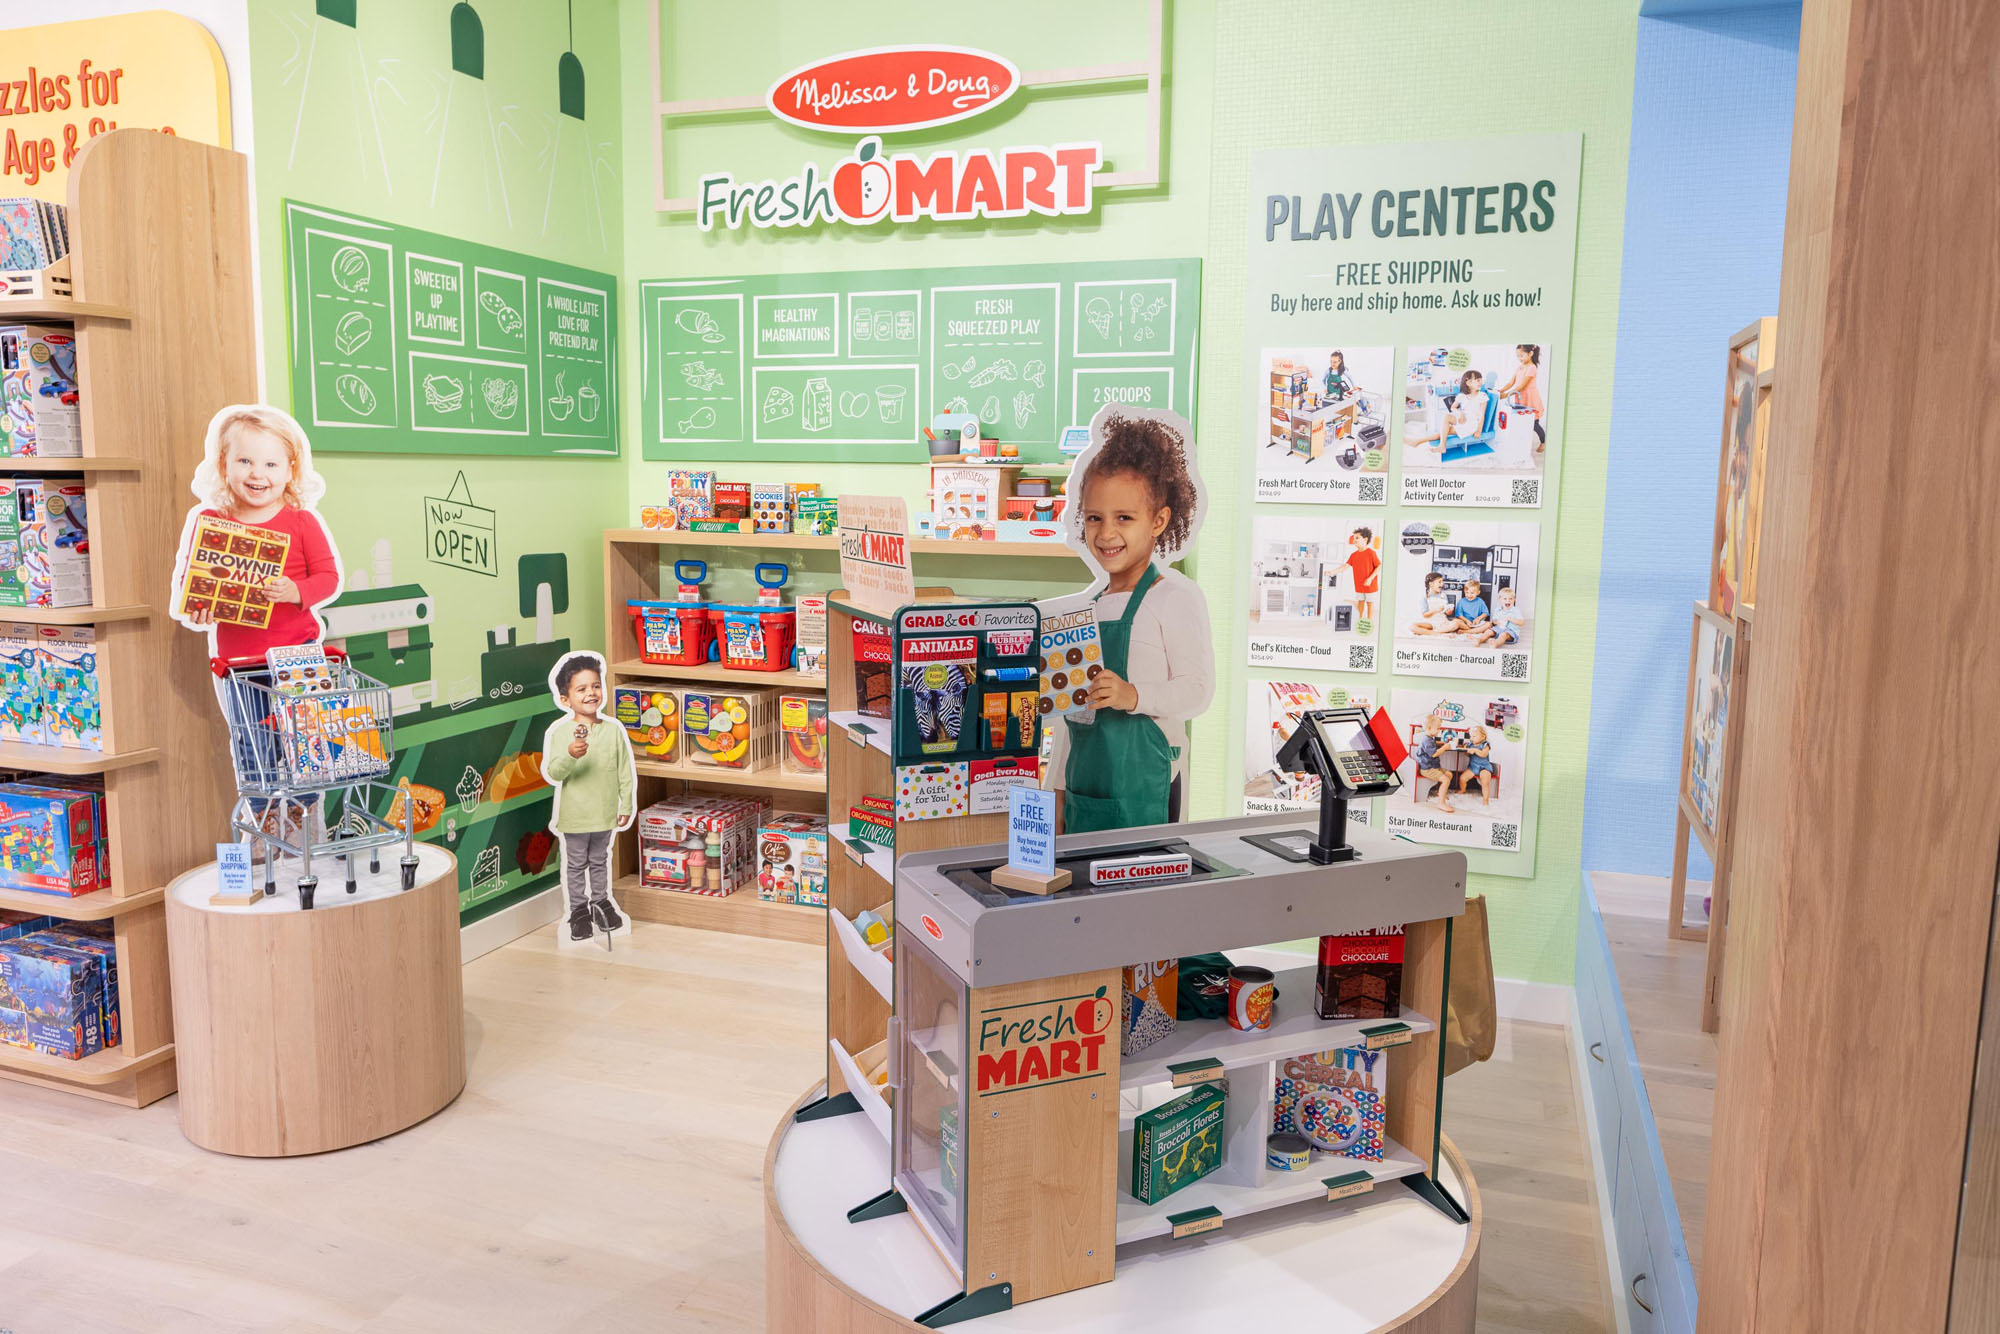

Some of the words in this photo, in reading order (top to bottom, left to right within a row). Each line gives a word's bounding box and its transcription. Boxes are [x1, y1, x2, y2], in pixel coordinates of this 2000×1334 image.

[77, 59, 123, 108] for
[790, 78, 897, 115] Melissa
[907, 73, 920, 98] &
[4, 128, 55, 186] Age
[63, 123, 80, 169] &
[702, 167, 833, 226] Fresh
[895, 148, 1097, 216] MART
[1266, 192, 1362, 241] PLAY
[1371, 180, 1556, 239] CENTERS
[413, 267, 458, 292] SWEETEN
[1335, 263, 1382, 286] FREE
[1387, 259, 1473, 285] SHIPPING
[430, 293, 443, 309] UP
[547, 294, 553, 308] A
[554, 296, 578, 314] WHOLE
[579, 300, 599, 318] LATTE
[975, 298, 1013, 316] FRESH
[1271, 293, 1297, 315] Buy
[1301, 293, 1333, 312] here
[1336, 291, 1364, 311] and
[1367, 292, 1398, 314] ship
[1402, 291, 1447, 310] home.
[1451, 289, 1479, 309] Ask
[1483, 293, 1501, 308] us
[1505, 287, 1542, 308] how!
[415, 311, 459, 334] PLAYTIME
[557, 315, 576, 331] LOVE
[577, 318, 590, 334] FOR
[774, 308, 817, 324] HEALTHY
[762, 325, 831, 343] IMAGINATIONS
[948, 319, 1008, 337] SQUEEZED
[1010, 318, 1041, 336] PLAY
[549, 331, 581, 351] PRETEND
[581, 336, 599, 352] PLAY
[1093, 387, 1101, 403] 2
[1104, 385, 1151, 403] SCOOPS
[671, 478, 707, 489] FRUITY
[715, 484, 732, 492] CAKE
[733, 484, 746, 492] MIX
[1258, 478, 1279, 488] Fresh
[1280, 479, 1297, 489] Mart
[1299, 479, 1328, 490] Grocery
[1329, 479, 1350, 489] Store
[1404, 478, 1418, 488] Get
[1420, 478, 1437, 488] Well
[1439, 478, 1466, 488] Doctor
[671, 488, 706, 498] CEREAL
[1404, 491, 1435, 502] Activity
[1437, 491, 1464, 501] Center
[431, 503, 463, 525] Now
[435, 530, 487, 568] OPEN
[842, 533, 862, 558] Fresh
[870, 533, 905, 566] MART
[196, 548, 281, 577] BROWNIE
[231, 570, 269, 586] MIX
[852, 619, 884, 635] CAKE
[984, 611, 1035, 626] Favorites
[1040, 611, 1094, 633] NDWICH
[908, 639, 974, 653] ANIMALS
[991, 635, 1025, 645] BUBBLE
[1251, 642, 1274, 653] Chef's
[1275, 644, 1304, 654] Kitchen
[1310, 646, 1332, 655] Cloud
[275, 655, 325, 668] COOKIES
[908, 651, 973, 662] ILLUSTRATED
[1396, 650, 1421, 661] Chef's
[1422, 652, 1453, 662] Kitchen
[1459, 654, 1495, 665] Charcoal
[1021, 697, 1031, 729] GRANOLA
[323, 712, 376, 739] RICE
[1021, 730, 1029, 744] BAR
[973, 772, 995, 781] Open
[995, 768, 1018, 778] Every
[1018, 768, 1037, 777] Day!
[915, 795, 930, 804] for
[931, 793, 950, 802] You!
[919, 787, 925, 795] A
[926, 785, 946, 794] Gift
[863, 799, 888, 810] ORGANIC
[1020, 804, 1044, 821] FREE
[1246, 801, 1273, 812] Snacks
[1274, 802, 1279, 812] &
[850, 810, 874, 822] ORGANIC
[874, 816, 893, 828] WHOLE
[1388, 816, 1406, 826] Star
[1407, 817, 1428, 828] Diner
[1428, 819, 1473, 833] Restaurant
[1017, 835, 1026, 845] Buy
[1026, 837, 1037, 847] here
[1037, 839, 1047, 848] and
[225, 853, 243, 862] FREE
[1020, 845, 1030, 855] ship
[1030, 847, 1043, 857] home
[1096, 868, 1125, 880] Next
[1129, 863, 1189, 877] Customer
[1341, 938, 1391, 947] CHOCOLATE
[1341, 953, 1389, 962] CHOCOLATE
[979, 1004, 1076, 1051] Fresh
[977, 1034, 1106, 1091] MART
[1298, 1048, 1379, 1073] RUITY
[1188, 1072, 1209, 1081] Snacks
[1283, 1060, 1378, 1093] CEREAL
[1154, 1100, 1187, 1120] Broccoli
[1187, 1090, 1214, 1106] Florets
[1157, 1125, 1191, 1155] Broccoli
[1193, 1109, 1220, 1132] Florets
[1141, 1129, 1151, 1161] Florets
[1286, 1156, 1309, 1165] TUNA
[1140, 1162, 1150, 1200] Broccoli
[1184, 1221, 1213, 1233] Vegetables
